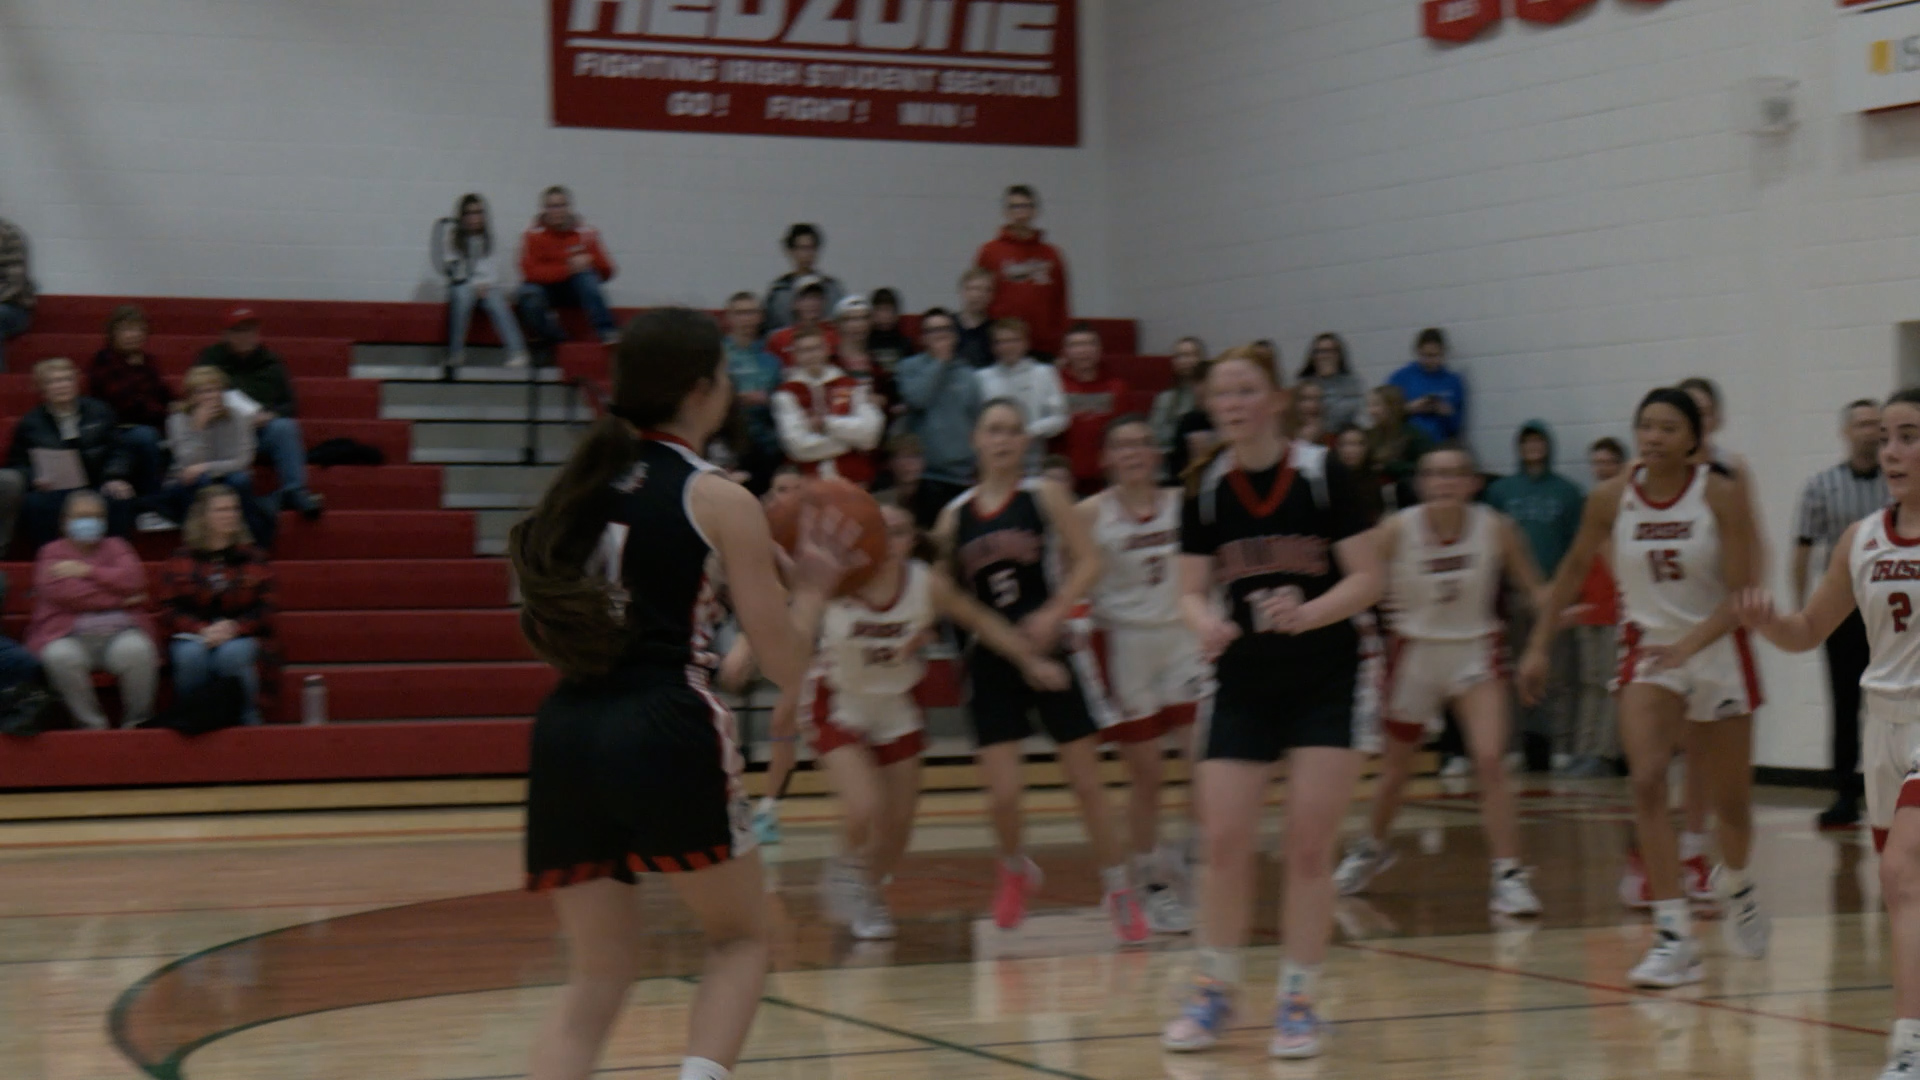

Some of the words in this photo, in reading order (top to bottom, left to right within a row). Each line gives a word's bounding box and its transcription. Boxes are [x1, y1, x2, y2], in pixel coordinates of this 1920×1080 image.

[573, 52, 718, 82] FIGHTING
[719, 59, 800, 86] IRISH
[803, 62, 936, 92] STUDENT
[937, 69, 1061, 98] SECTION
[666, 91, 730, 117] GO!
[897, 101, 976, 128] WIN!
[987, 567, 1020, 608] 5
[1888, 592, 1912, 633] 2
